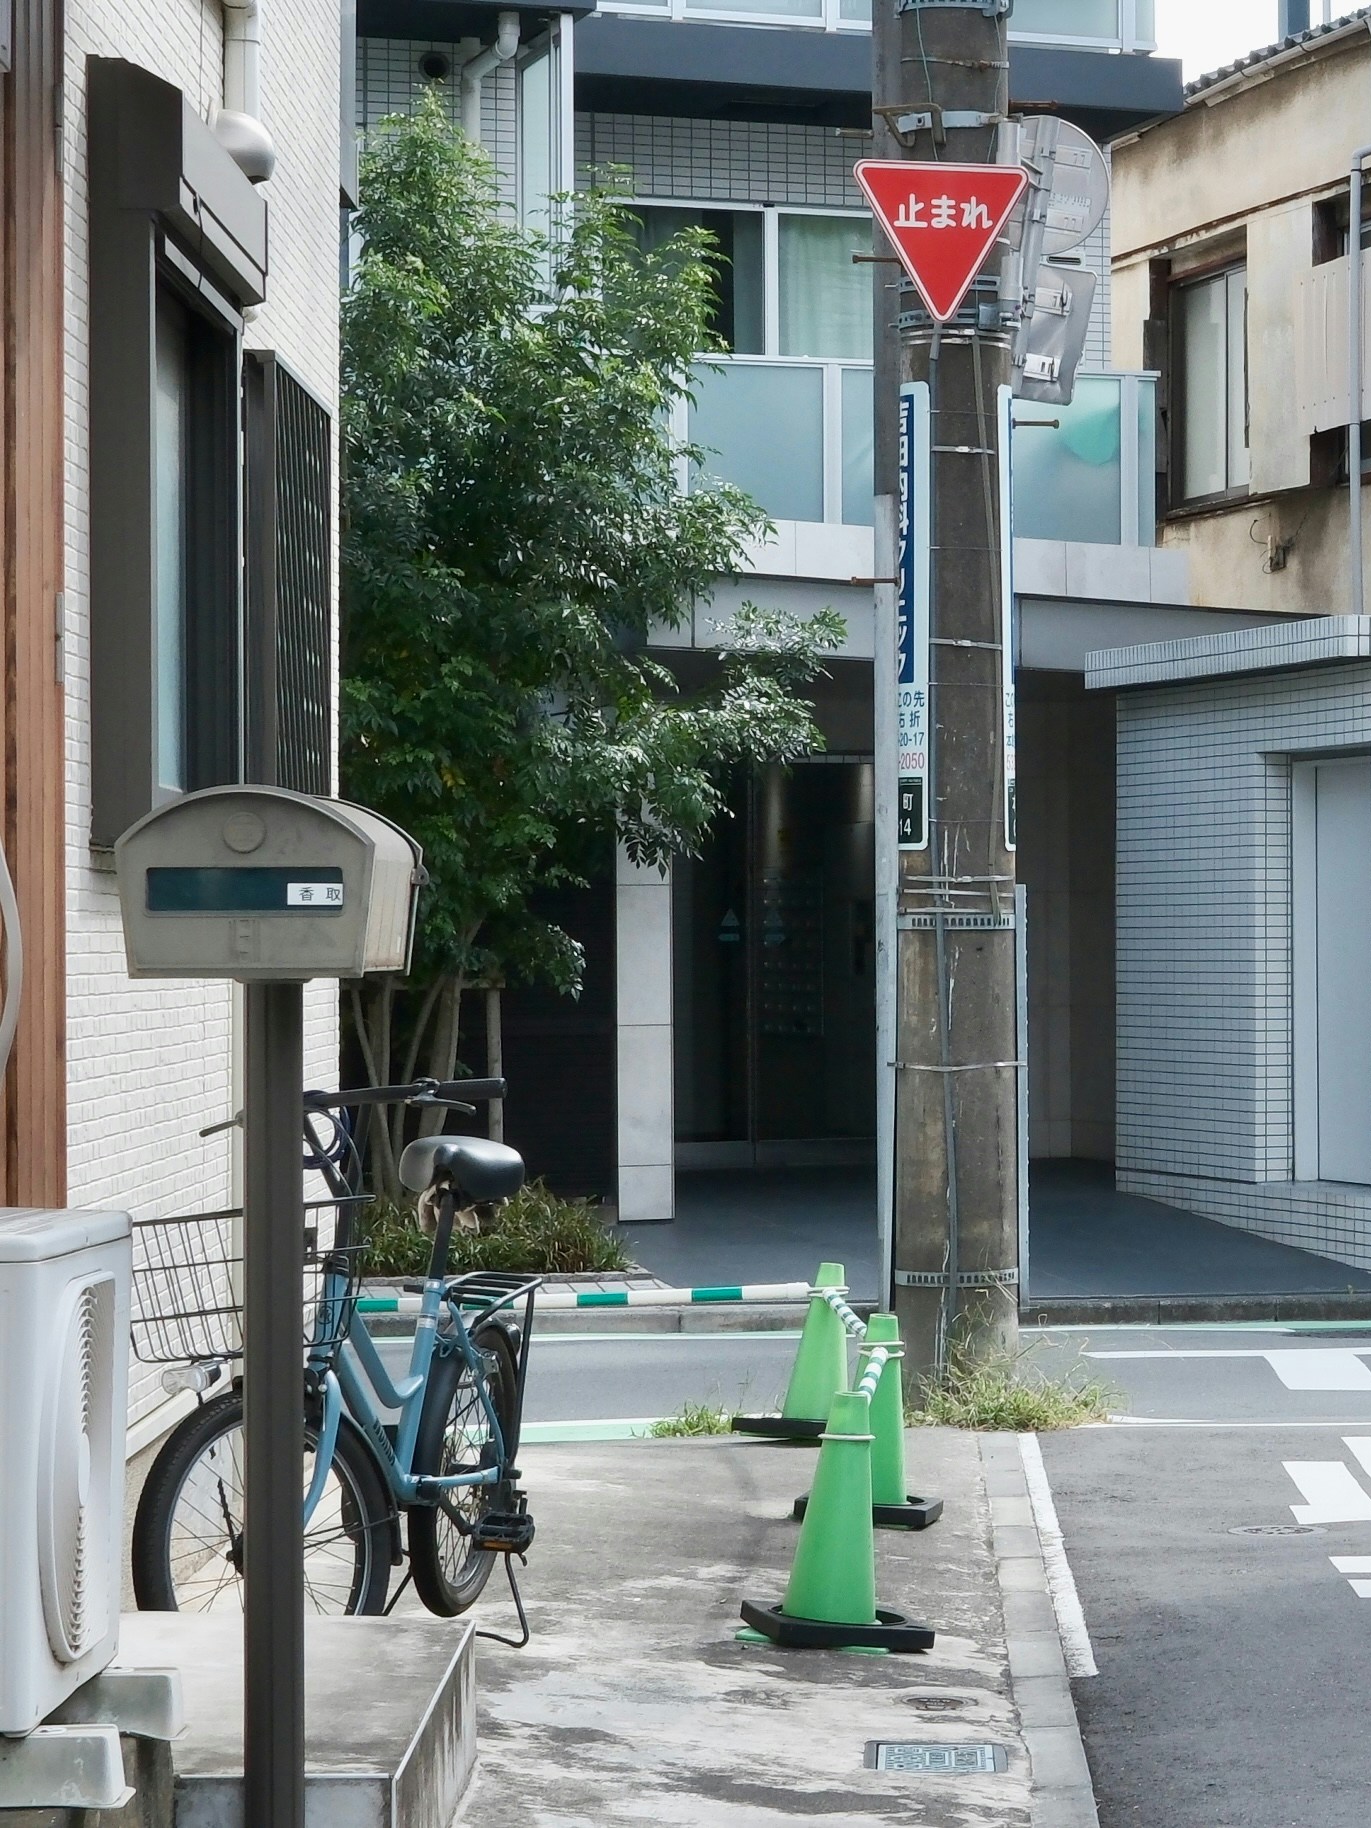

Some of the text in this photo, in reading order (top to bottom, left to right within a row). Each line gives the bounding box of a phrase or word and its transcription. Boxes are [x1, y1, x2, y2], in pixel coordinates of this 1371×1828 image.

[893, 193, 993, 229] 止まれ
[299, 886, 342, 901] 香取
